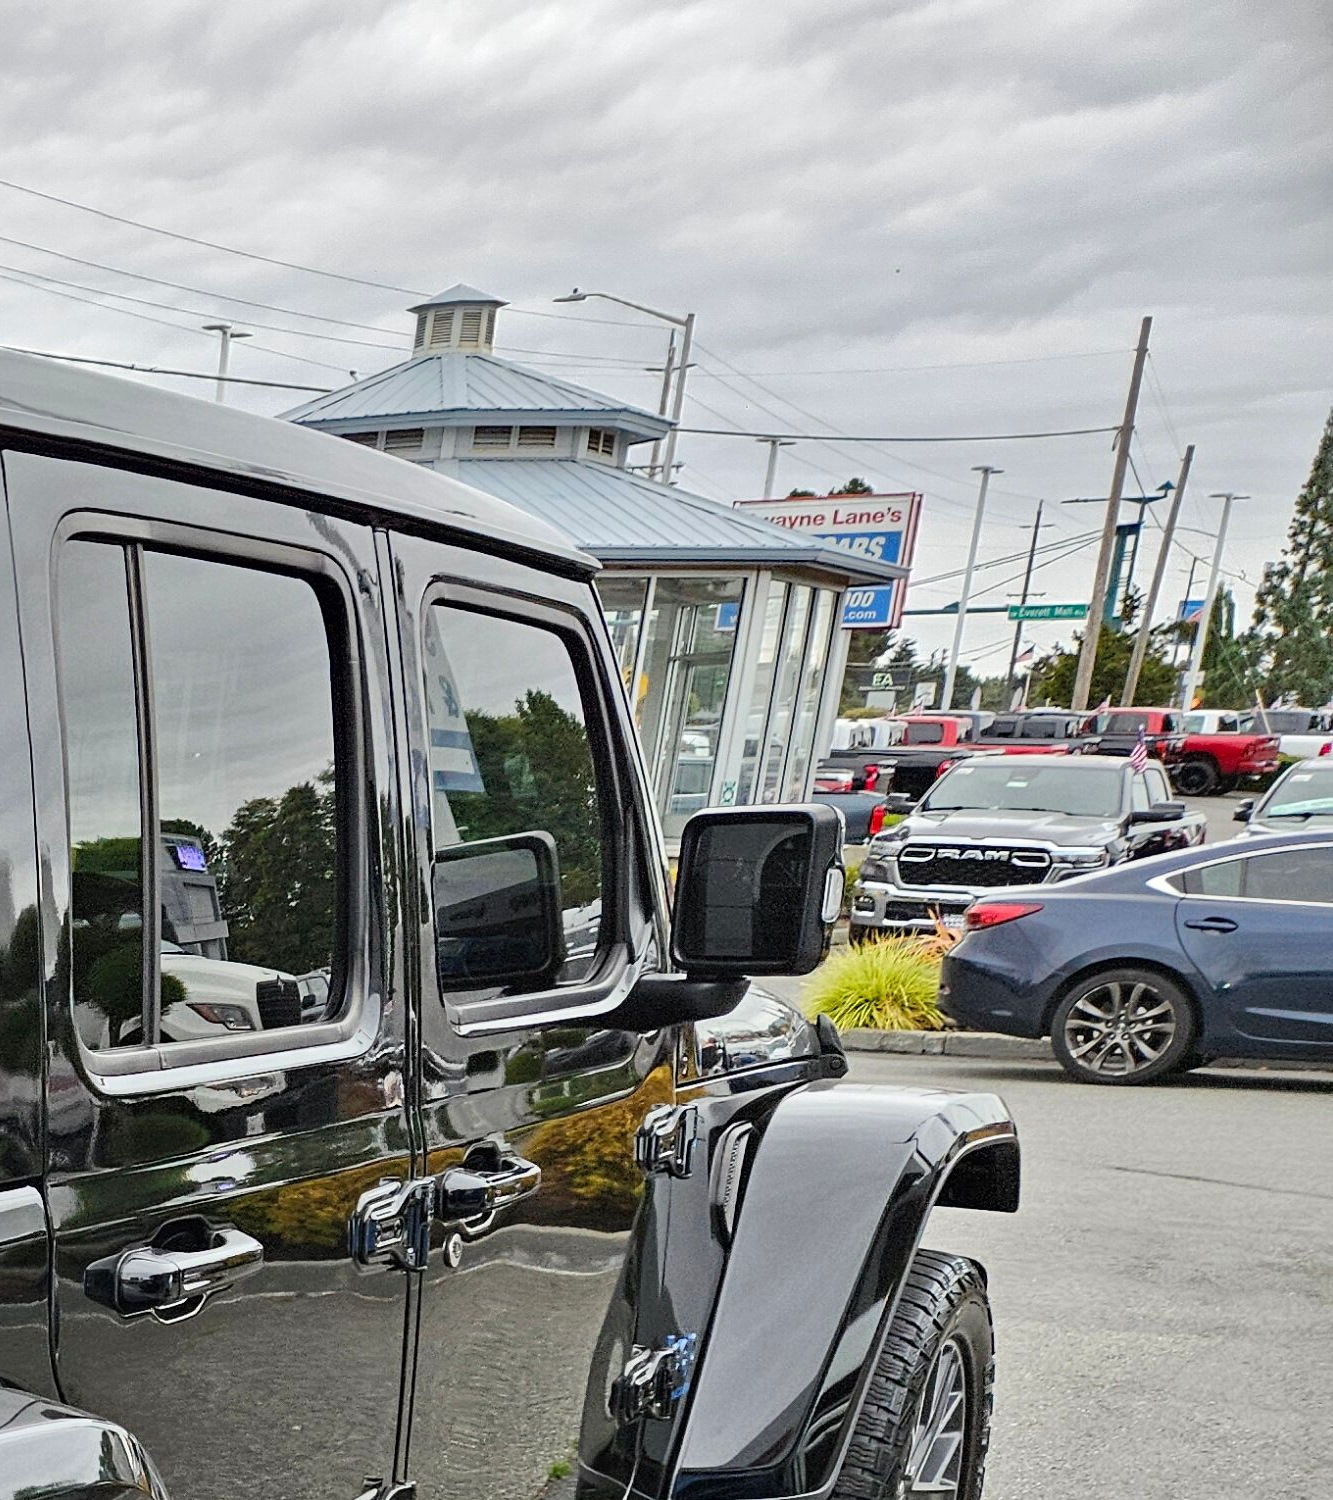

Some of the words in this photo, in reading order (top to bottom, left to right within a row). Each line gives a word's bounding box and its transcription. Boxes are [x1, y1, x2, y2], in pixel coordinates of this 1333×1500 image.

[764, 512, 826, 530] ayne
[832, 506, 903, 525] Lane's
[936, 848, 1010, 862] RAM
